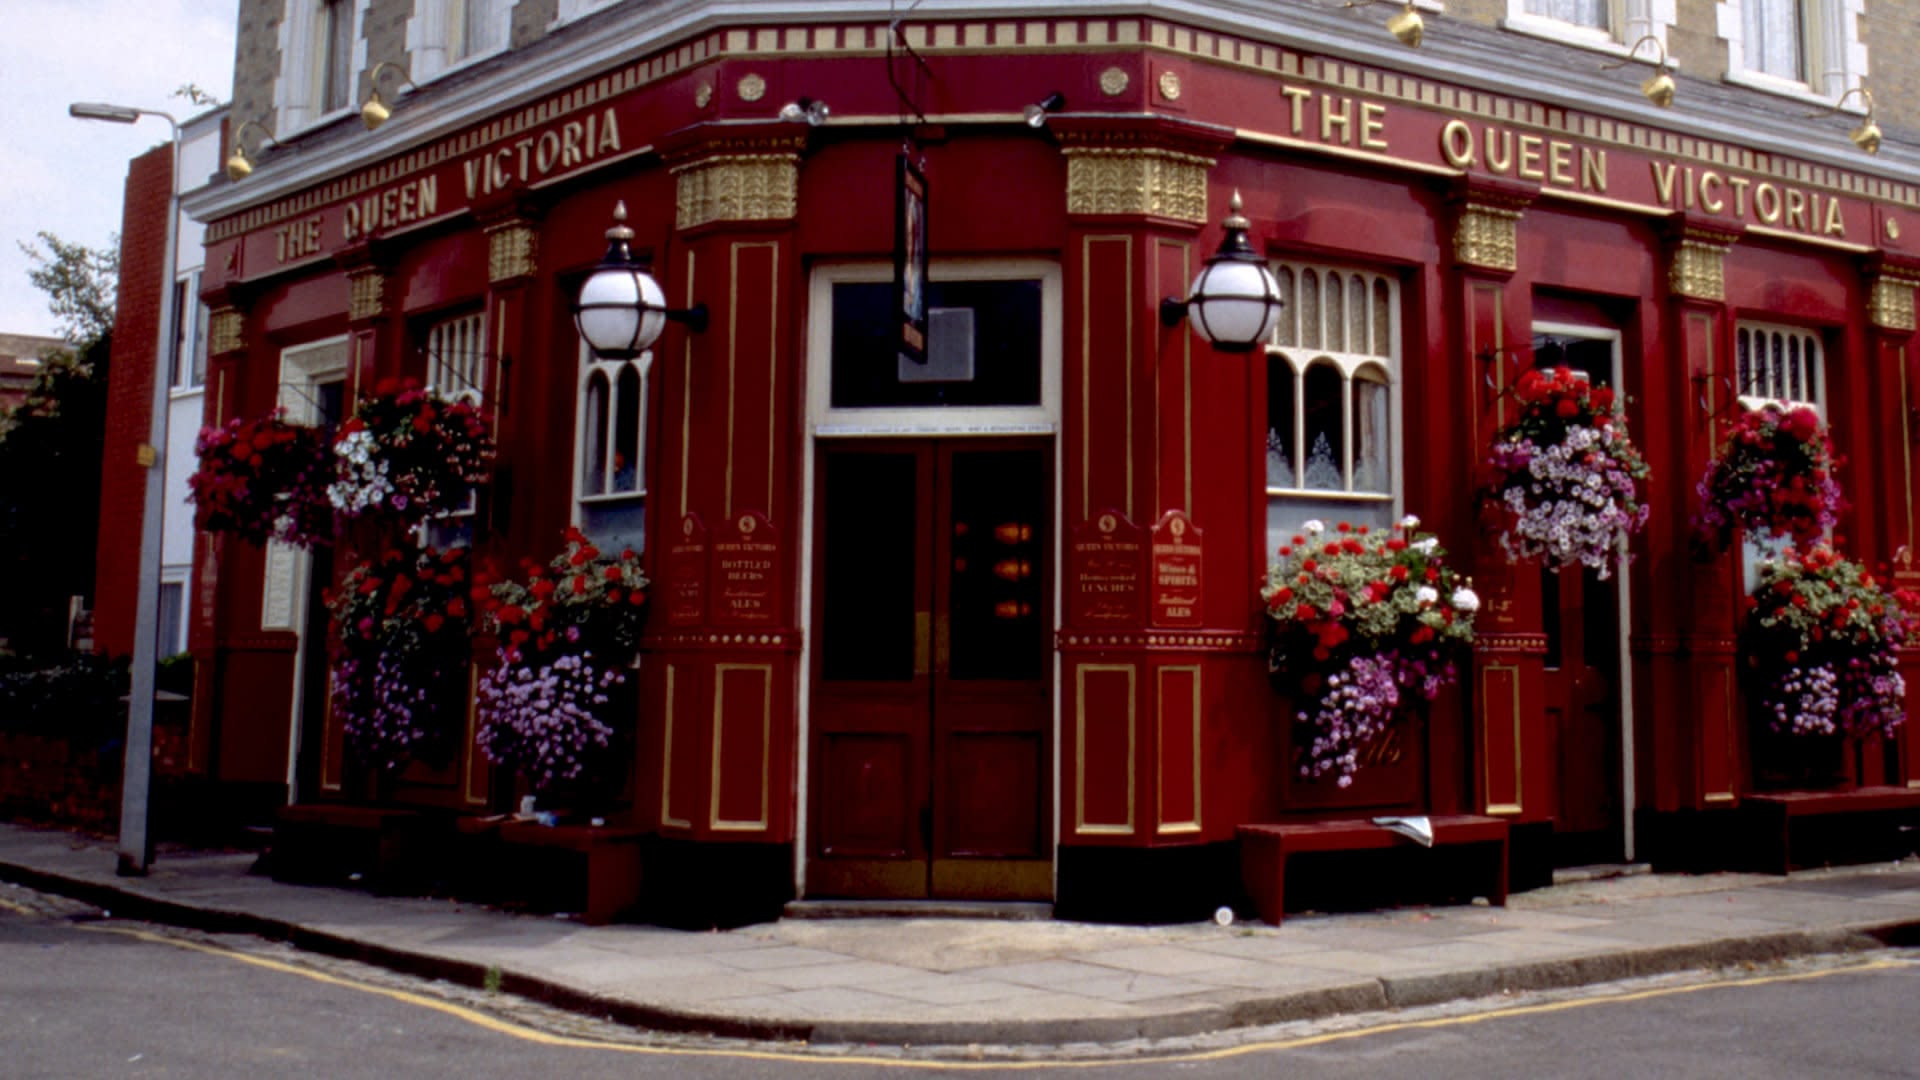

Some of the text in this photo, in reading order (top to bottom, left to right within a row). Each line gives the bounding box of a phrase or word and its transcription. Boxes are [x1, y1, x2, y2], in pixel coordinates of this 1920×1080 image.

[274, 107, 622, 263] THE QUEEN VICTORIA
[1281, 85, 1846, 237] THE QUEEN VICTORIA
